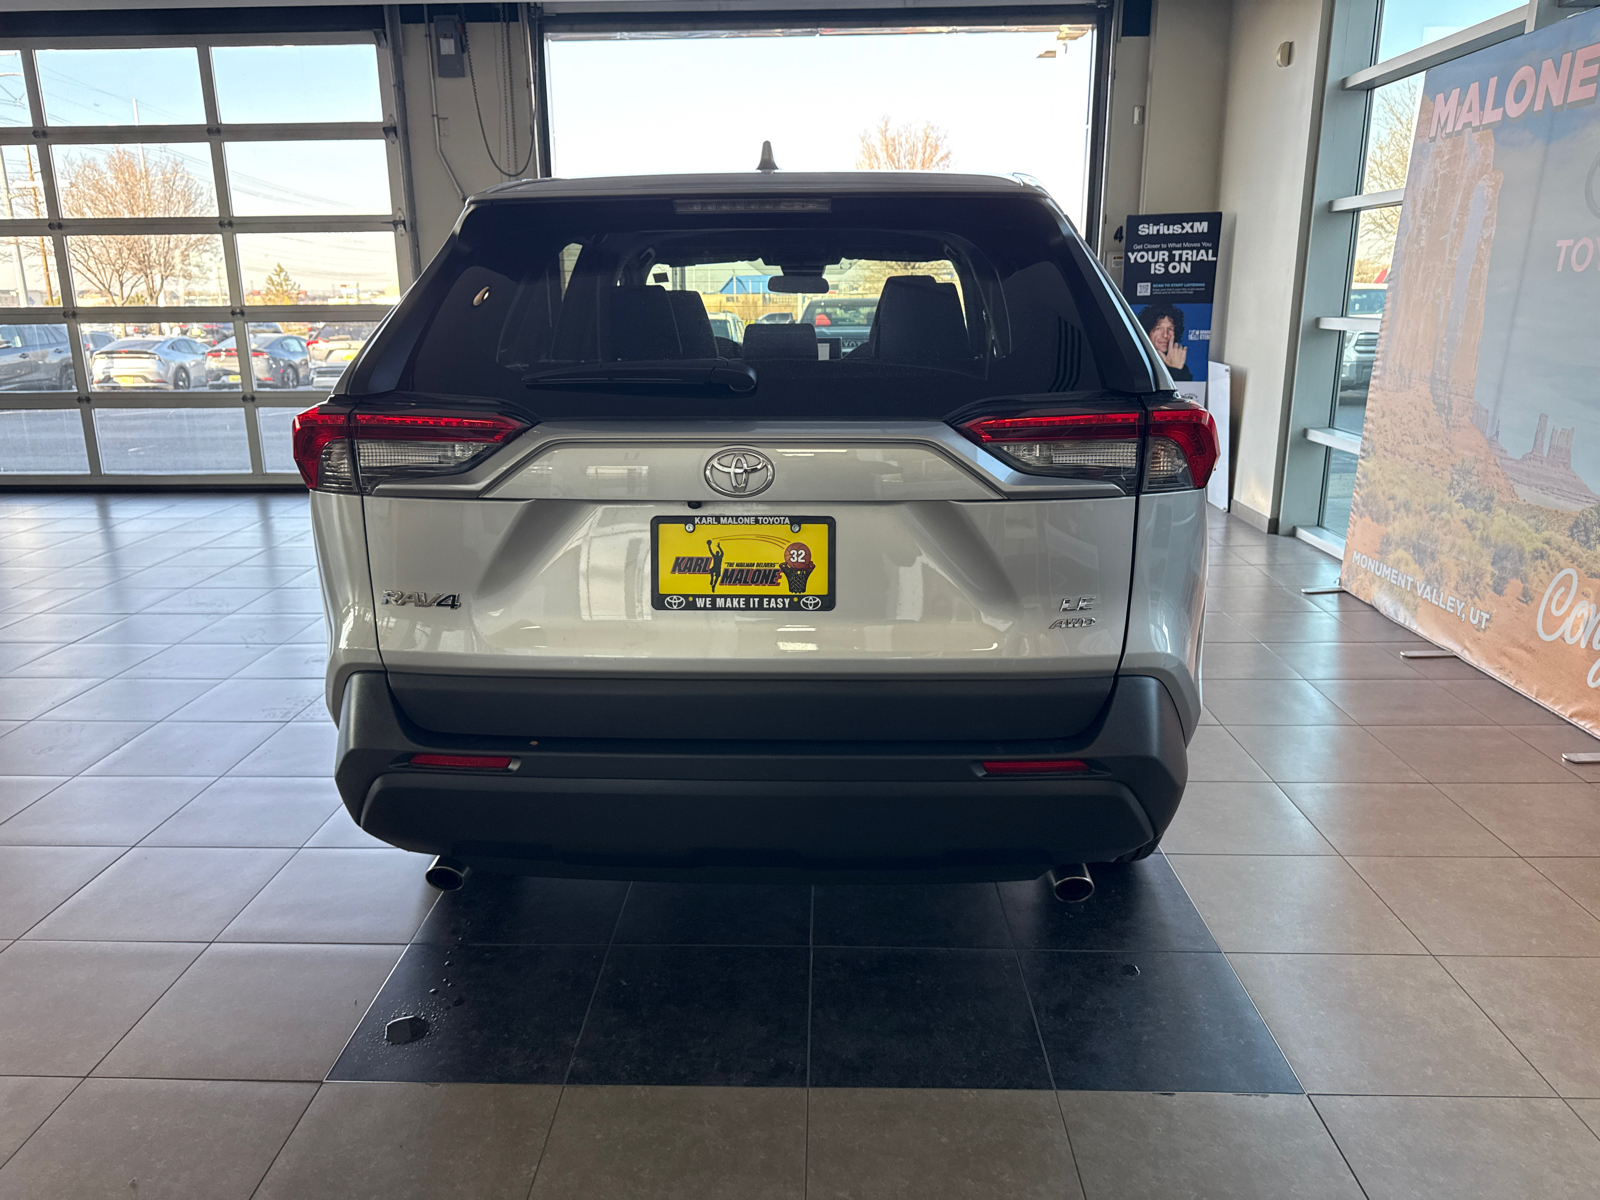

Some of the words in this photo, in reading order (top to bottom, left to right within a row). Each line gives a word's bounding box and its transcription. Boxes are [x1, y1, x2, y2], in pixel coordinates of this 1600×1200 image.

[1428, 43, 1600, 138] MALONE
[1113, 225, 1124, 243] 4
[1138, 221, 1208, 235] SiriusXM
[1127, 250, 1169, 263] YOUR
[1172, 249, 1217, 262] TRIAL
[1556, 237, 1600, 272] TO
[1150, 262, 1165, 275] IS
[1168, 261, 1191, 274] ON
[694, 516, 718, 524] KARL
[720, 516, 756, 524] MALONE
[757, 516, 791, 524] TOYOTA
[790, 549, 806, 563] 32
[671, 556, 712, 574] KARL
[719, 568, 781, 586] MALONE
[1352, 550, 1414, 591] MONUMENT
[1416, 581, 1466, 622] VALLEY,
[1469, 606, 1490, 629] UT
[381, 590, 462, 609] RAV4
[695, 597, 712, 608] WE
[716, 597, 746, 608] MAKE
[750, 597, 760, 608] IT
[763, 597, 790, 608] EASY
[1059, 596, 1096, 612] LE
[1048, 617, 1096, 629] AWD
